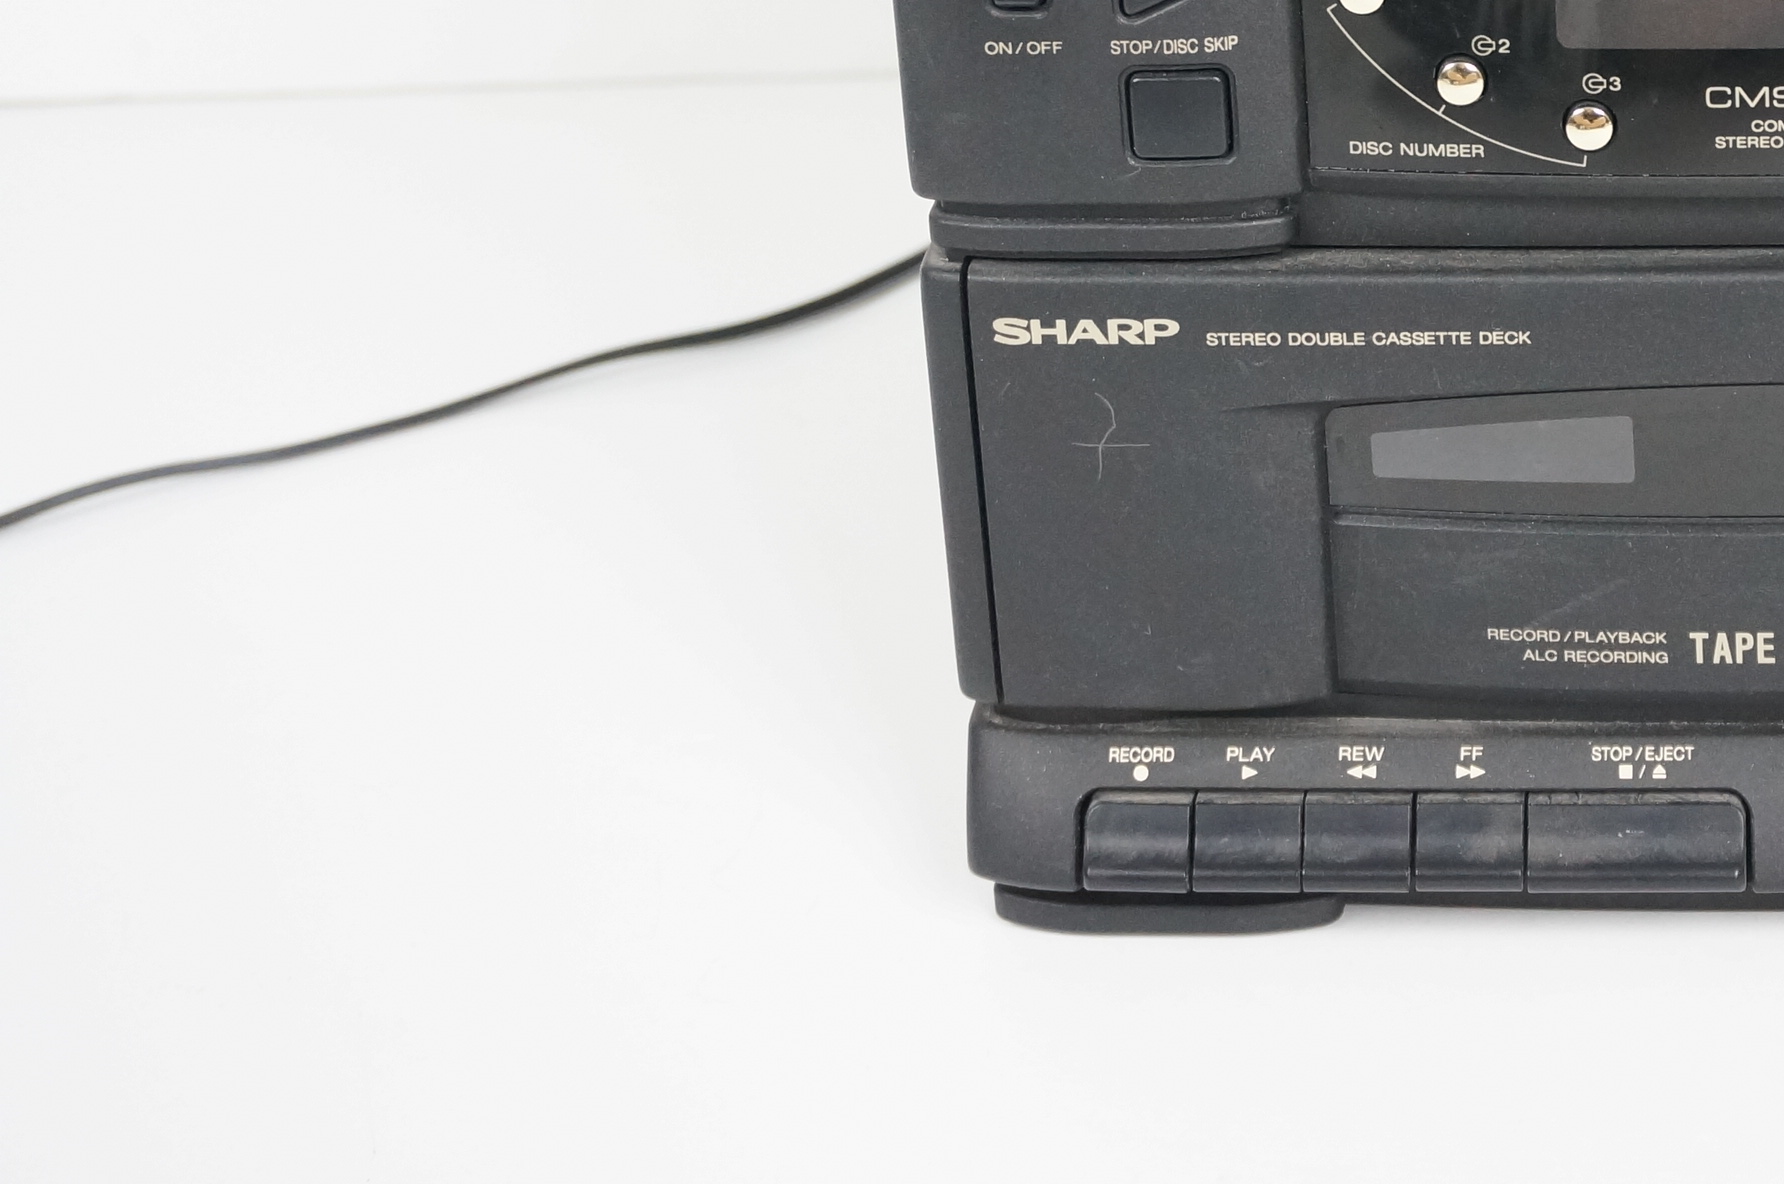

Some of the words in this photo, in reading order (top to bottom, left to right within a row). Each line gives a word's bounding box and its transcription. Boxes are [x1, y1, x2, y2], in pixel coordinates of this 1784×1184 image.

[1204, 36, 1238, 52] SKIP
[1499, 39, 1510, 53] 2
[1609, 77, 1621, 91] 3
[1350, 141, 1392, 155] DISC
[1400, 143, 1484, 157] NUMBER
[1715, 136, 1783, 148] STEREO
[993, 318, 1180, 345] SHARP
[1207, 333, 1281, 346] STEREO
[1288, 333, 1365, 345] DOUBLE
[1372, 332, 1471, 345] CASSETTE
[1480, 331, 1531, 344] DECK
[1523, 649, 1557, 661] ALC
[1564, 650, 1668, 663] RECORDING
[1689, 633, 1775, 664] TAPE
[1109, 747, 1174, 762] RECORD
[1227, 747, 1275, 761] PLAY
[1339, 746, 1384, 761] REW
[1461, 747, 1483, 761] FF
